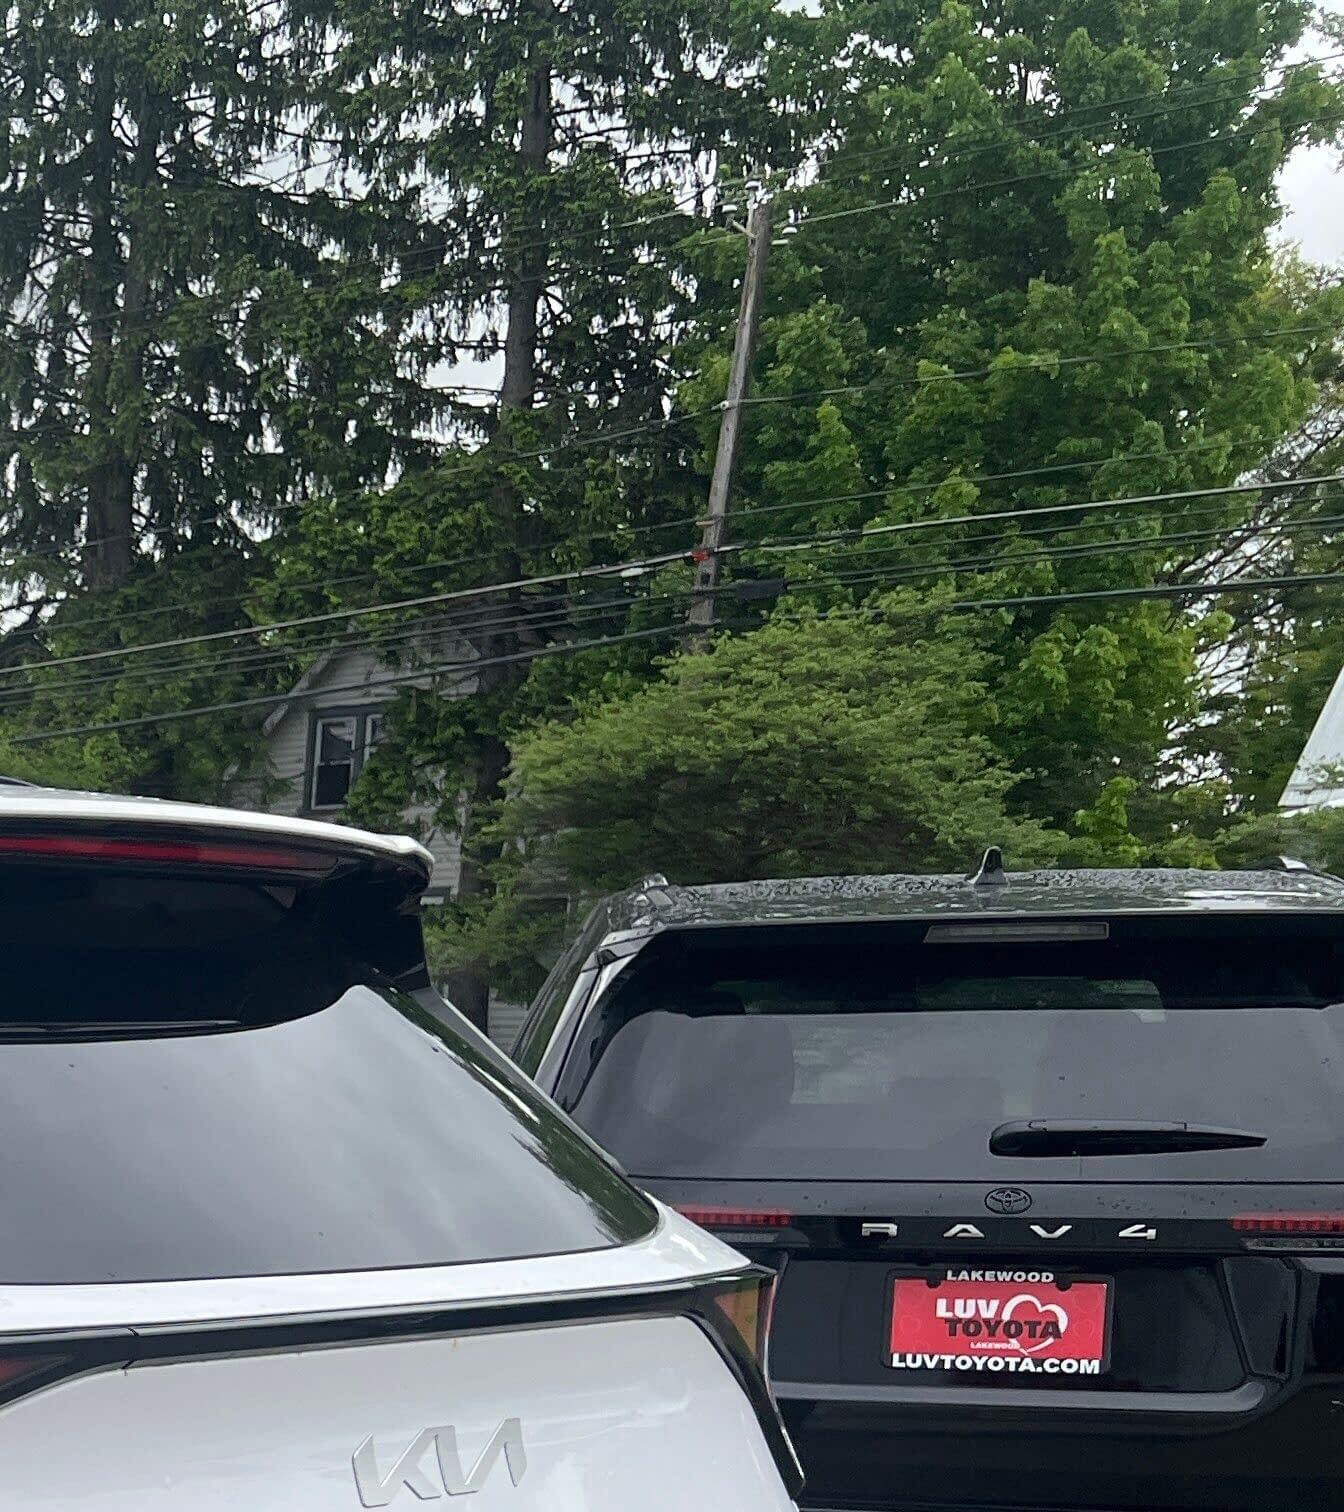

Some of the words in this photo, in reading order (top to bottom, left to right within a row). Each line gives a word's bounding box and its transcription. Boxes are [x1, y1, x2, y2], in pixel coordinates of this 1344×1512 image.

[946, 1269, 1054, 1283] LAKEWOOD
[935, 1298, 1000, 1319] LUV
[944, 1319, 1062, 1339] TOYOTA
[970, 1341, 1021, 1350] LAKEWOOD
[891, 1352, 1101, 1375] LUVTOYOTA.COM
[352, 1417, 528, 1509] KIA
